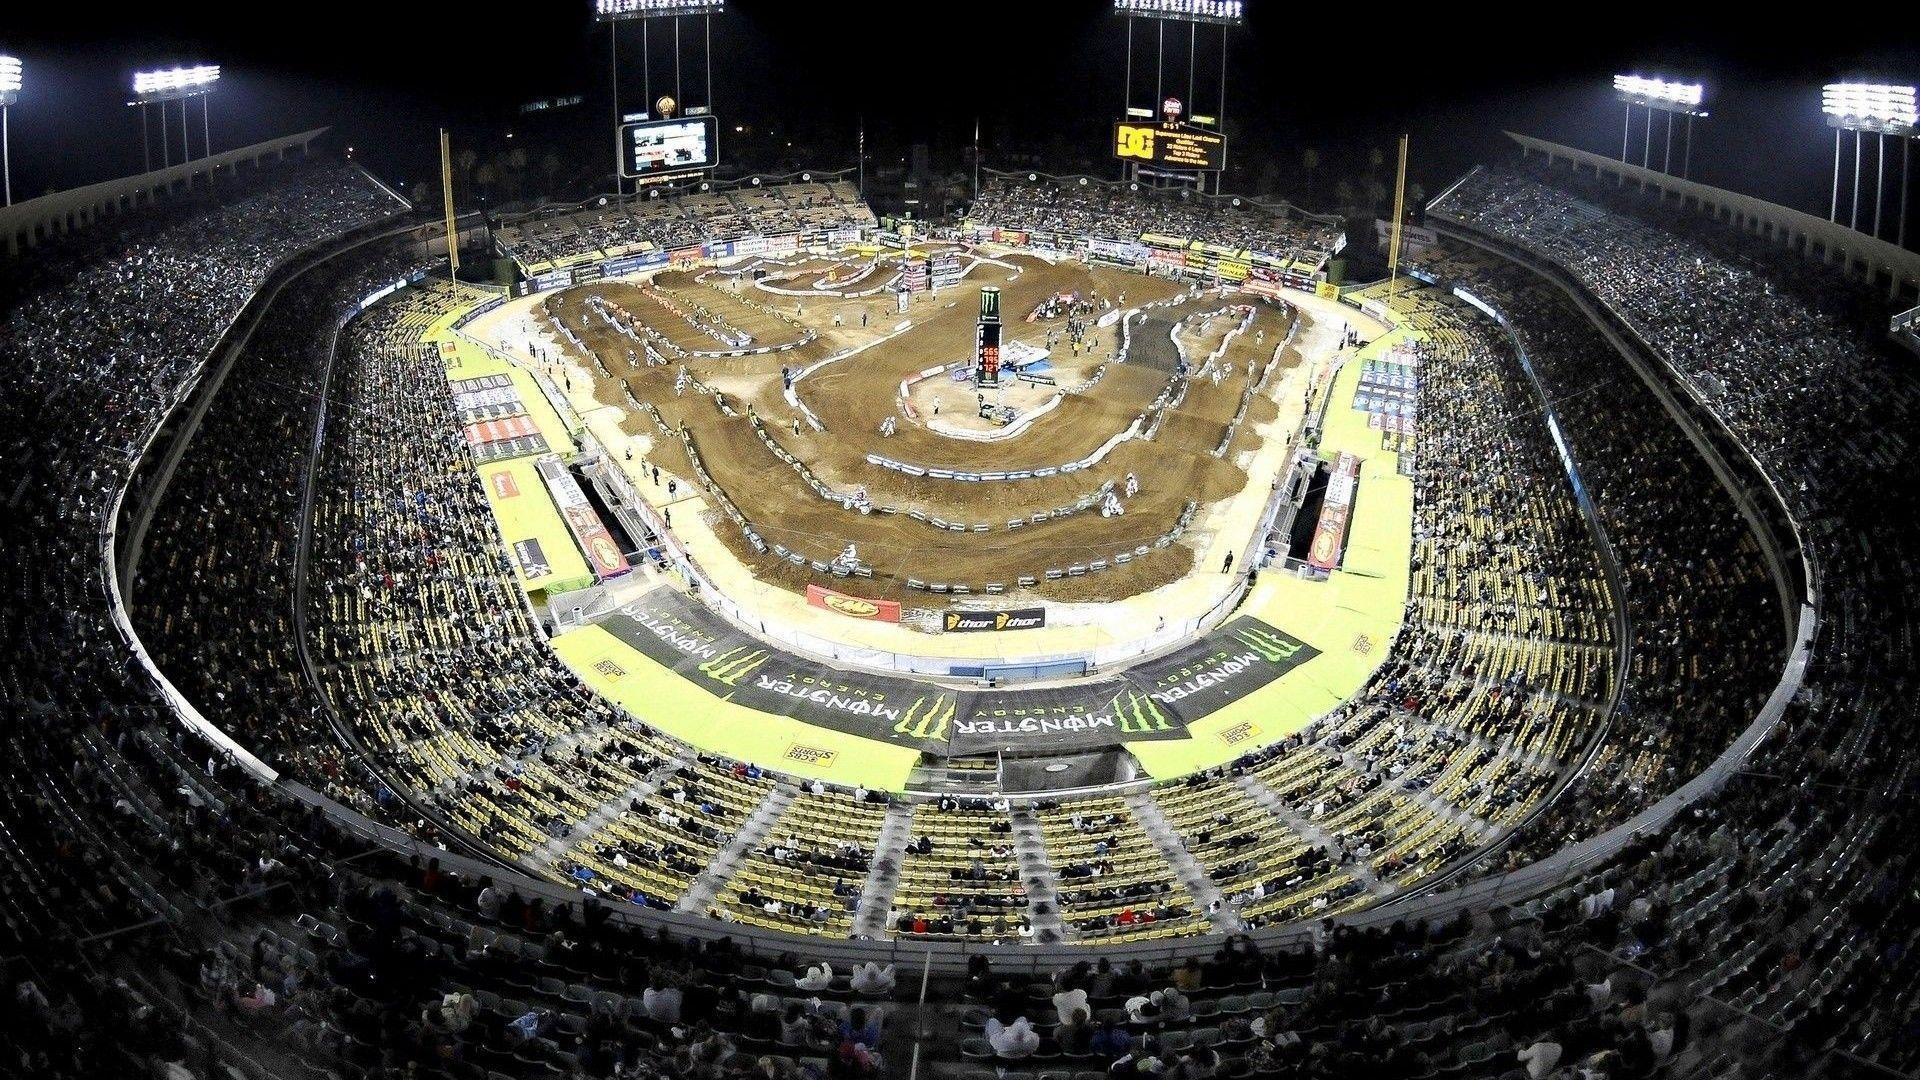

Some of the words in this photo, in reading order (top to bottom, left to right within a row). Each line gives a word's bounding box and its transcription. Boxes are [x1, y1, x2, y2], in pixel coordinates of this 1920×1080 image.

[620, 605, 717, 660] MONSTER
[650, 607, 716, 642] ENERGY
[957, 619, 994, 628] thor
[1006, 617, 1042, 627] thor
[1150, 651, 1261, 704] MONSTER
[1156, 651, 1228, 688] ENERGY
[756, 674, 900, 721] MONSTER
[786, 673, 886, 701] ENERGY
[953, 712, 1115, 734] MONSTER
[975, 705, 1086, 718] ENERGY
[791, 746, 834, 760] SPORTS
